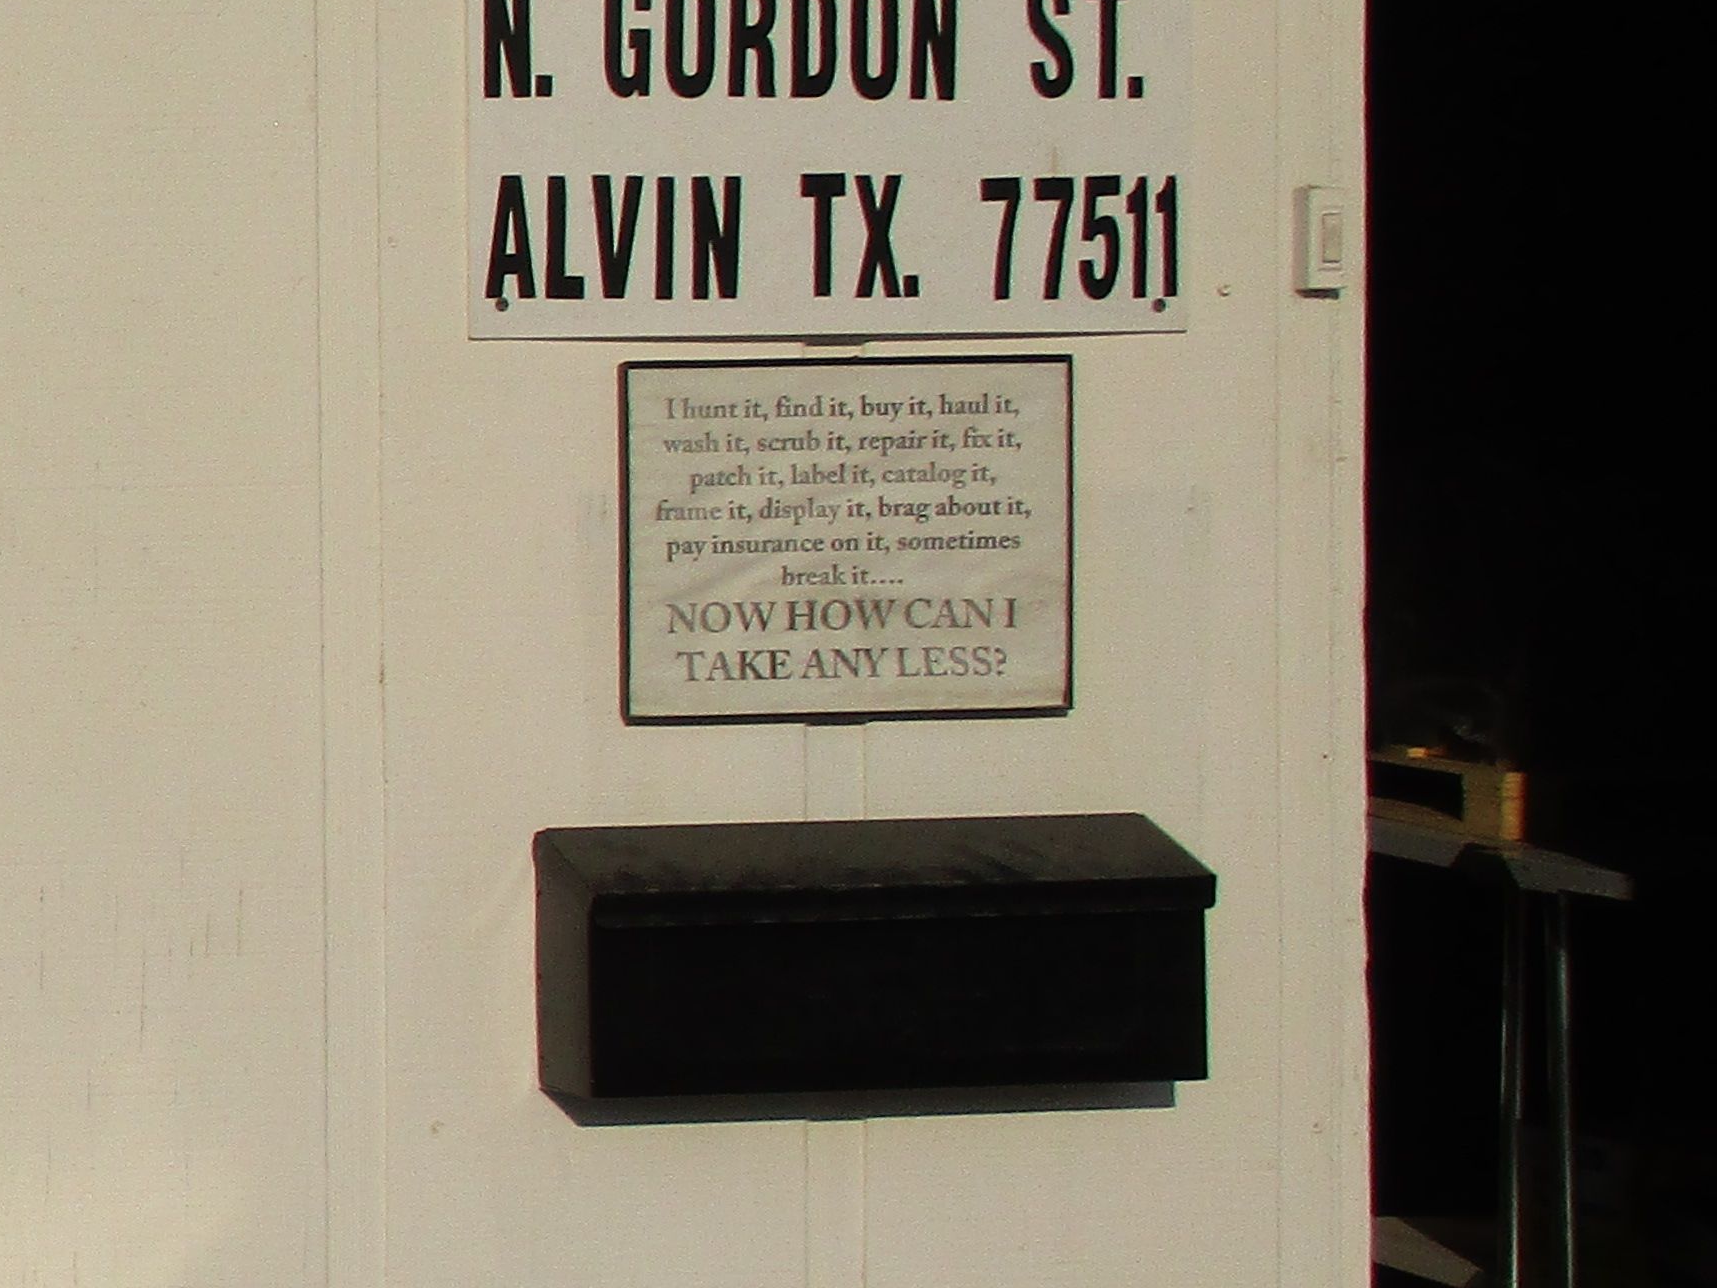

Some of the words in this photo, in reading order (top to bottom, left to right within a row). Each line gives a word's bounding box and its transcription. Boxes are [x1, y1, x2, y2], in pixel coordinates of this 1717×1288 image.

[484, 174, 741, 300] ALVIN
[800, 173, 920, 298] TX.
[980, 174, 1178, 300] 77511
[665, 398, 676, 419] I
[682, 398, 738, 418] hunt
[743, 399, 768, 421] it,
[775, 395, 823, 417] find
[828, 397, 854, 420] it,
[860, 394, 904, 422] buy
[908, 396, 933, 418] it,
[939, 393, 989, 414] haul
[994, 395, 1019, 417] it,
[664, 432, 719, 453] wash
[726, 433, 750, 454] it,
[757, 430, 820, 451] scrub
[826, 431, 851, 454] it,
[858, 430, 927, 456] repair
[932, 428, 955, 451] it,
[963, 426, 993, 448] fix
[997, 429, 1022, 450] it,
[690, 465, 751, 494] patch
[758, 466, 784, 488] it,
[791, 463, 845, 484] label
[851, 465, 875, 487] it,
[881, 462, 967, 489] catalog
[971, 463, 997, 485] it,
[656, 499, 722, 521] frame
[728, 500, 752, 523] it,
[759, 497, 841, 525] display
[846, 499, 871, 521] it,
[878, 496, 931, 523] brag
[935, 495, 1003, 515] about
[1007, 496, 1032, 518] it,
[667, 541, 708, 562] pay
[712, 535, 824, 553] insurance
[830, 537, 859, 552] on
[867, 532, 890, 556] it,
[897, 530, 1021, 550] sometimes
[781, 564, 846, 585] break
[666, 601, 777, 634] NOW
[786, 598, 897, 631] HOW
[905, 598, 993, 629] CAN
[1004, 598, 1017, 628] I
[676, 649, 793, 681] TAKE
[799, 647, 888, 679] ANY
[896, 646, 1007, 677] LESS?
